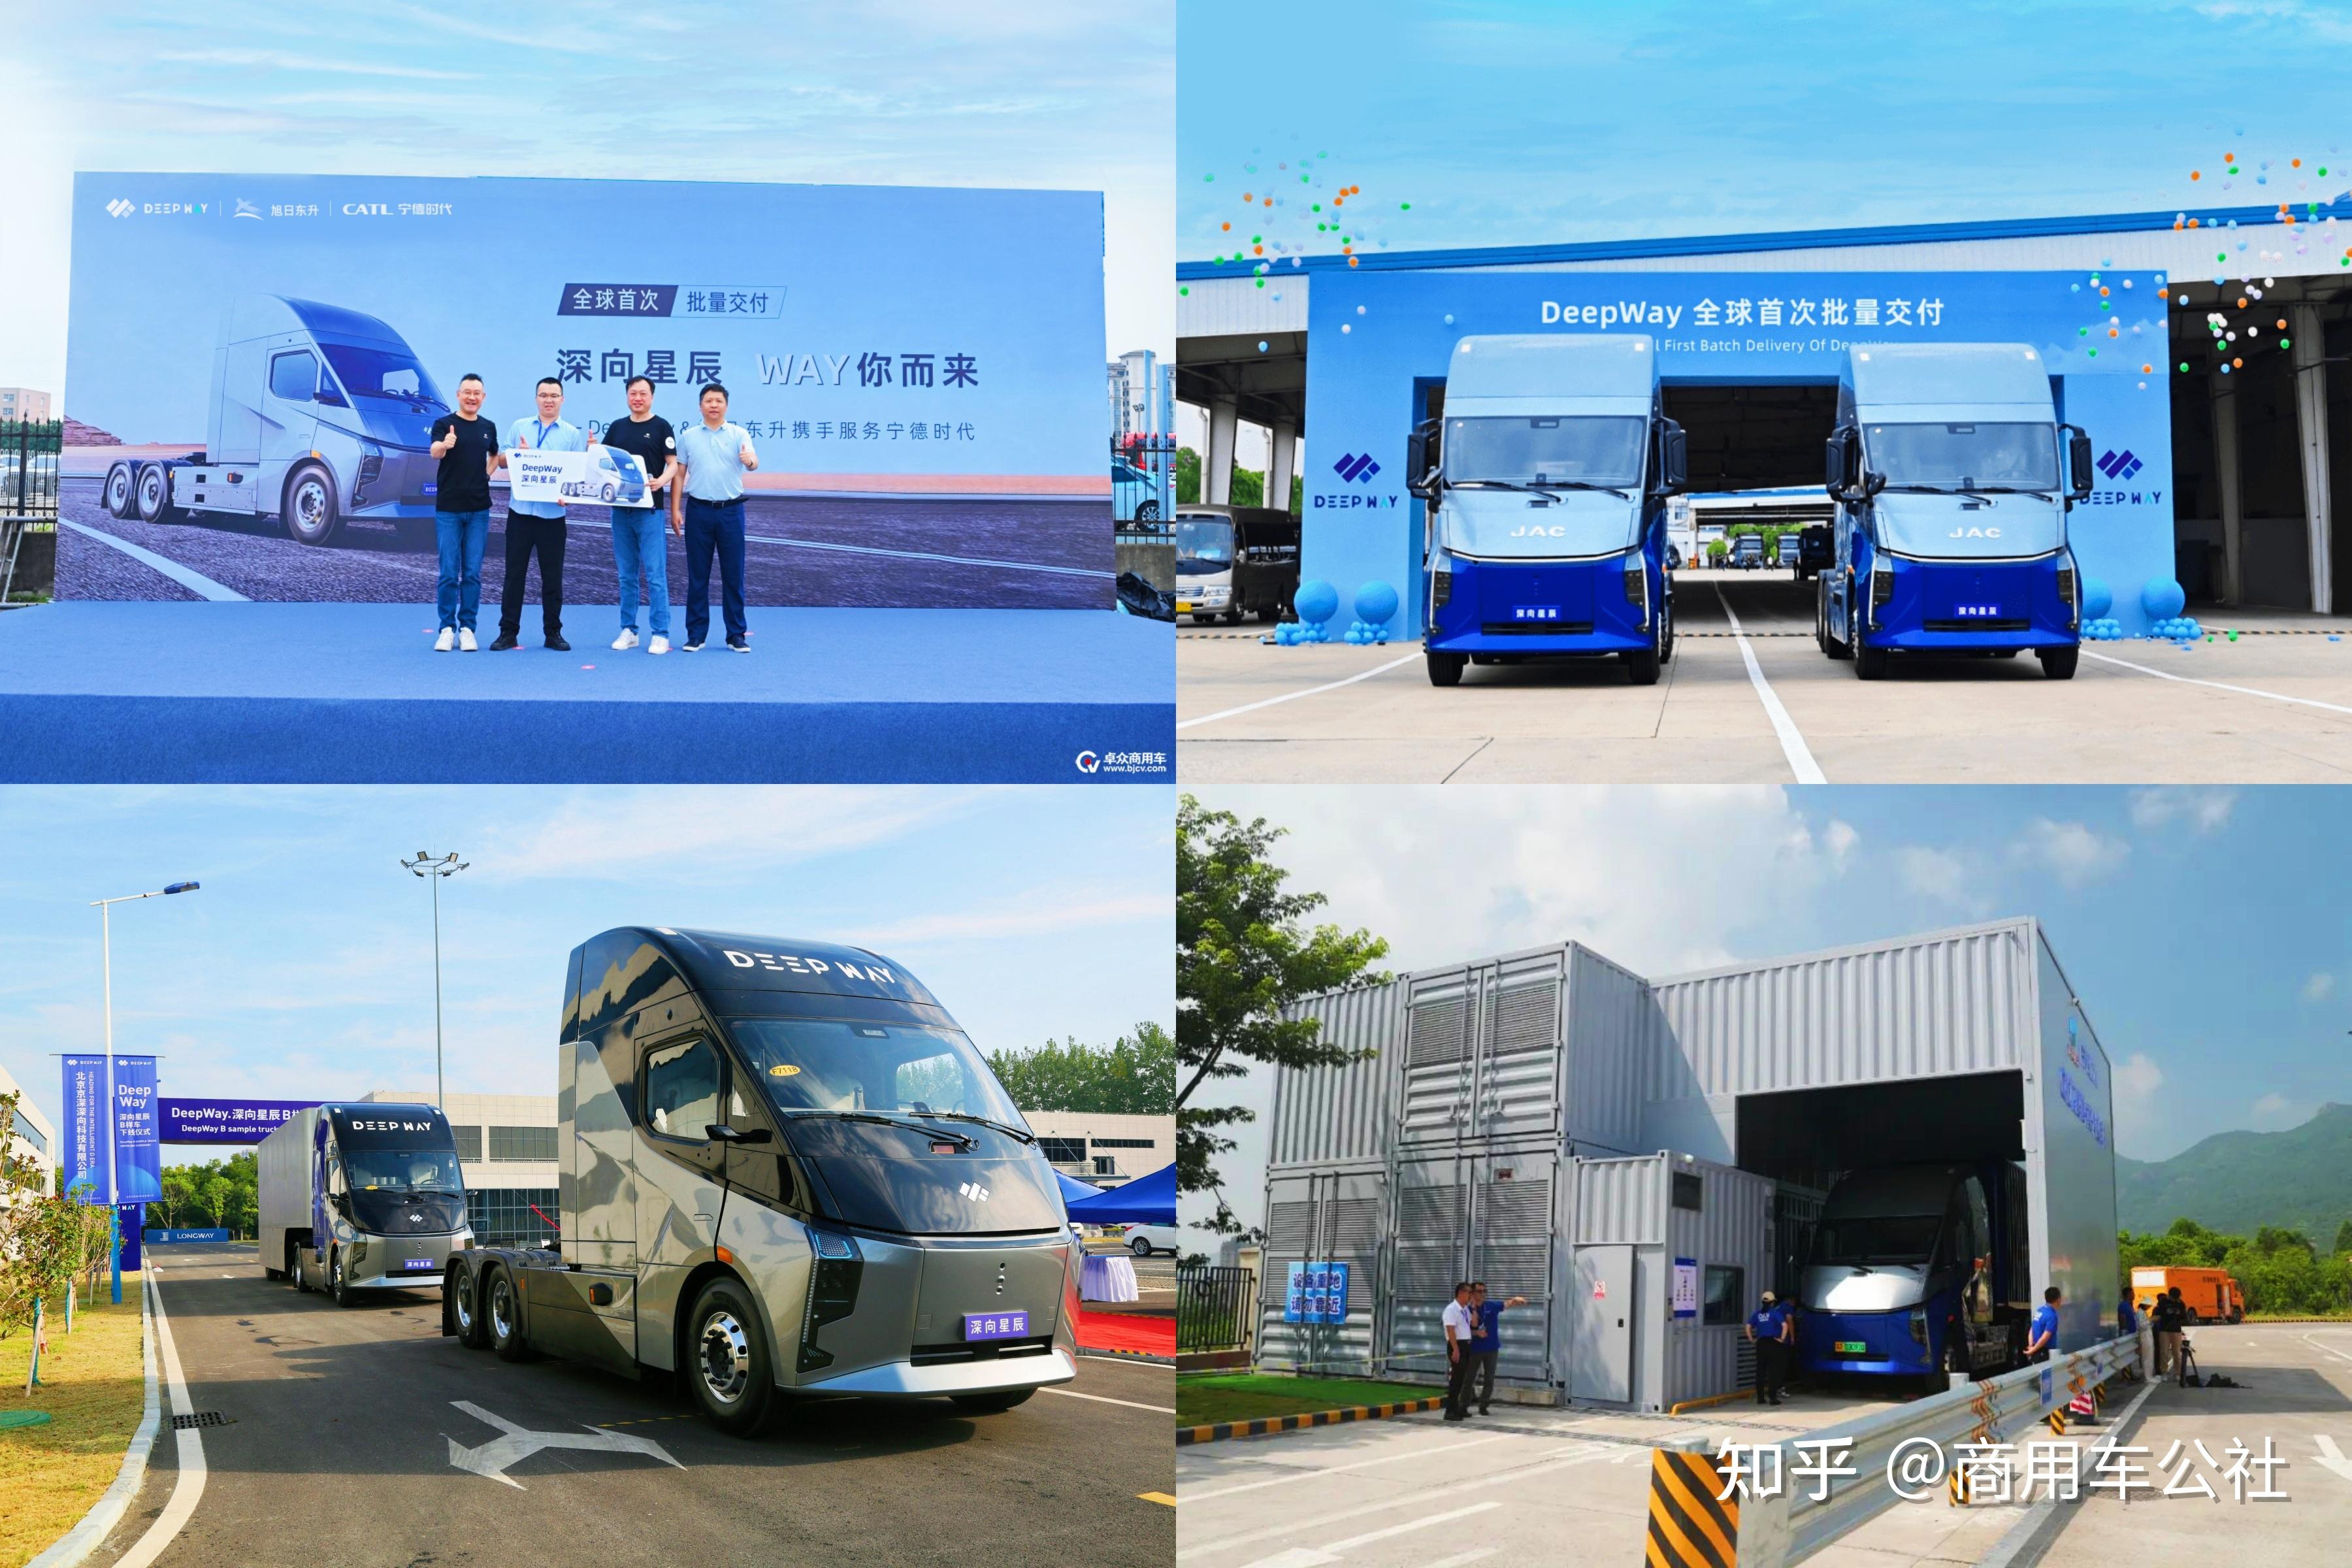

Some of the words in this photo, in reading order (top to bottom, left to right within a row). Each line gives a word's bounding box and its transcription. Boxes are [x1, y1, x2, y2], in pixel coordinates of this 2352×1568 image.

[144, 203, 180, 214] DEEP
[184, 203, 208, 214] WAY
[271, 204, 319, 217] 旭日东升
[342, 203, 394, 215] CATL
[398, 203, 453, 216] 宁德时代
[573, 288, 659, 312] 全球首次
[687, 291, 769, 314] 批量交付
[1542, 301, 1682, 329] DeepWay
[1693, 298, 1944, 326] 全球首次批量交付
[1665, 339, 1695, 351] First
[1701, 340, 1740, 351] Batch
[1746, 339, 1803, 353] Delivery
[1810, 339, 1826, 351] Of
[557, 348, 723, 385] 深向星辰
[522, 464, 563, 474] DeepWay
[521, 474, 557, 483] 深向星辰
[1314, 495, 1362, 508] DEEP
[1367, 495, 1398, 508] WAY
[2131, 492, 2161, 504] WAY
[1510, 525, 1566, 538] JAC
[1948, 527, 2002, 538] JAC
[723, 950, 830, 975] DEEP
[834, 961, 896, 984] WAY
[118, 1085, 151, 1097] Deep
[120, 1097, 146, 1109] Way
[76, 1071, 87, 1180] 北京京深深向科技有限公司
[182, 1124, 218, 1134] DeepWay
[351, 1121, 399, 1131] DEEP
[402, 1122, 431, 1131] WAY
[970, 1317, 1024, 1334] 深向星辰
